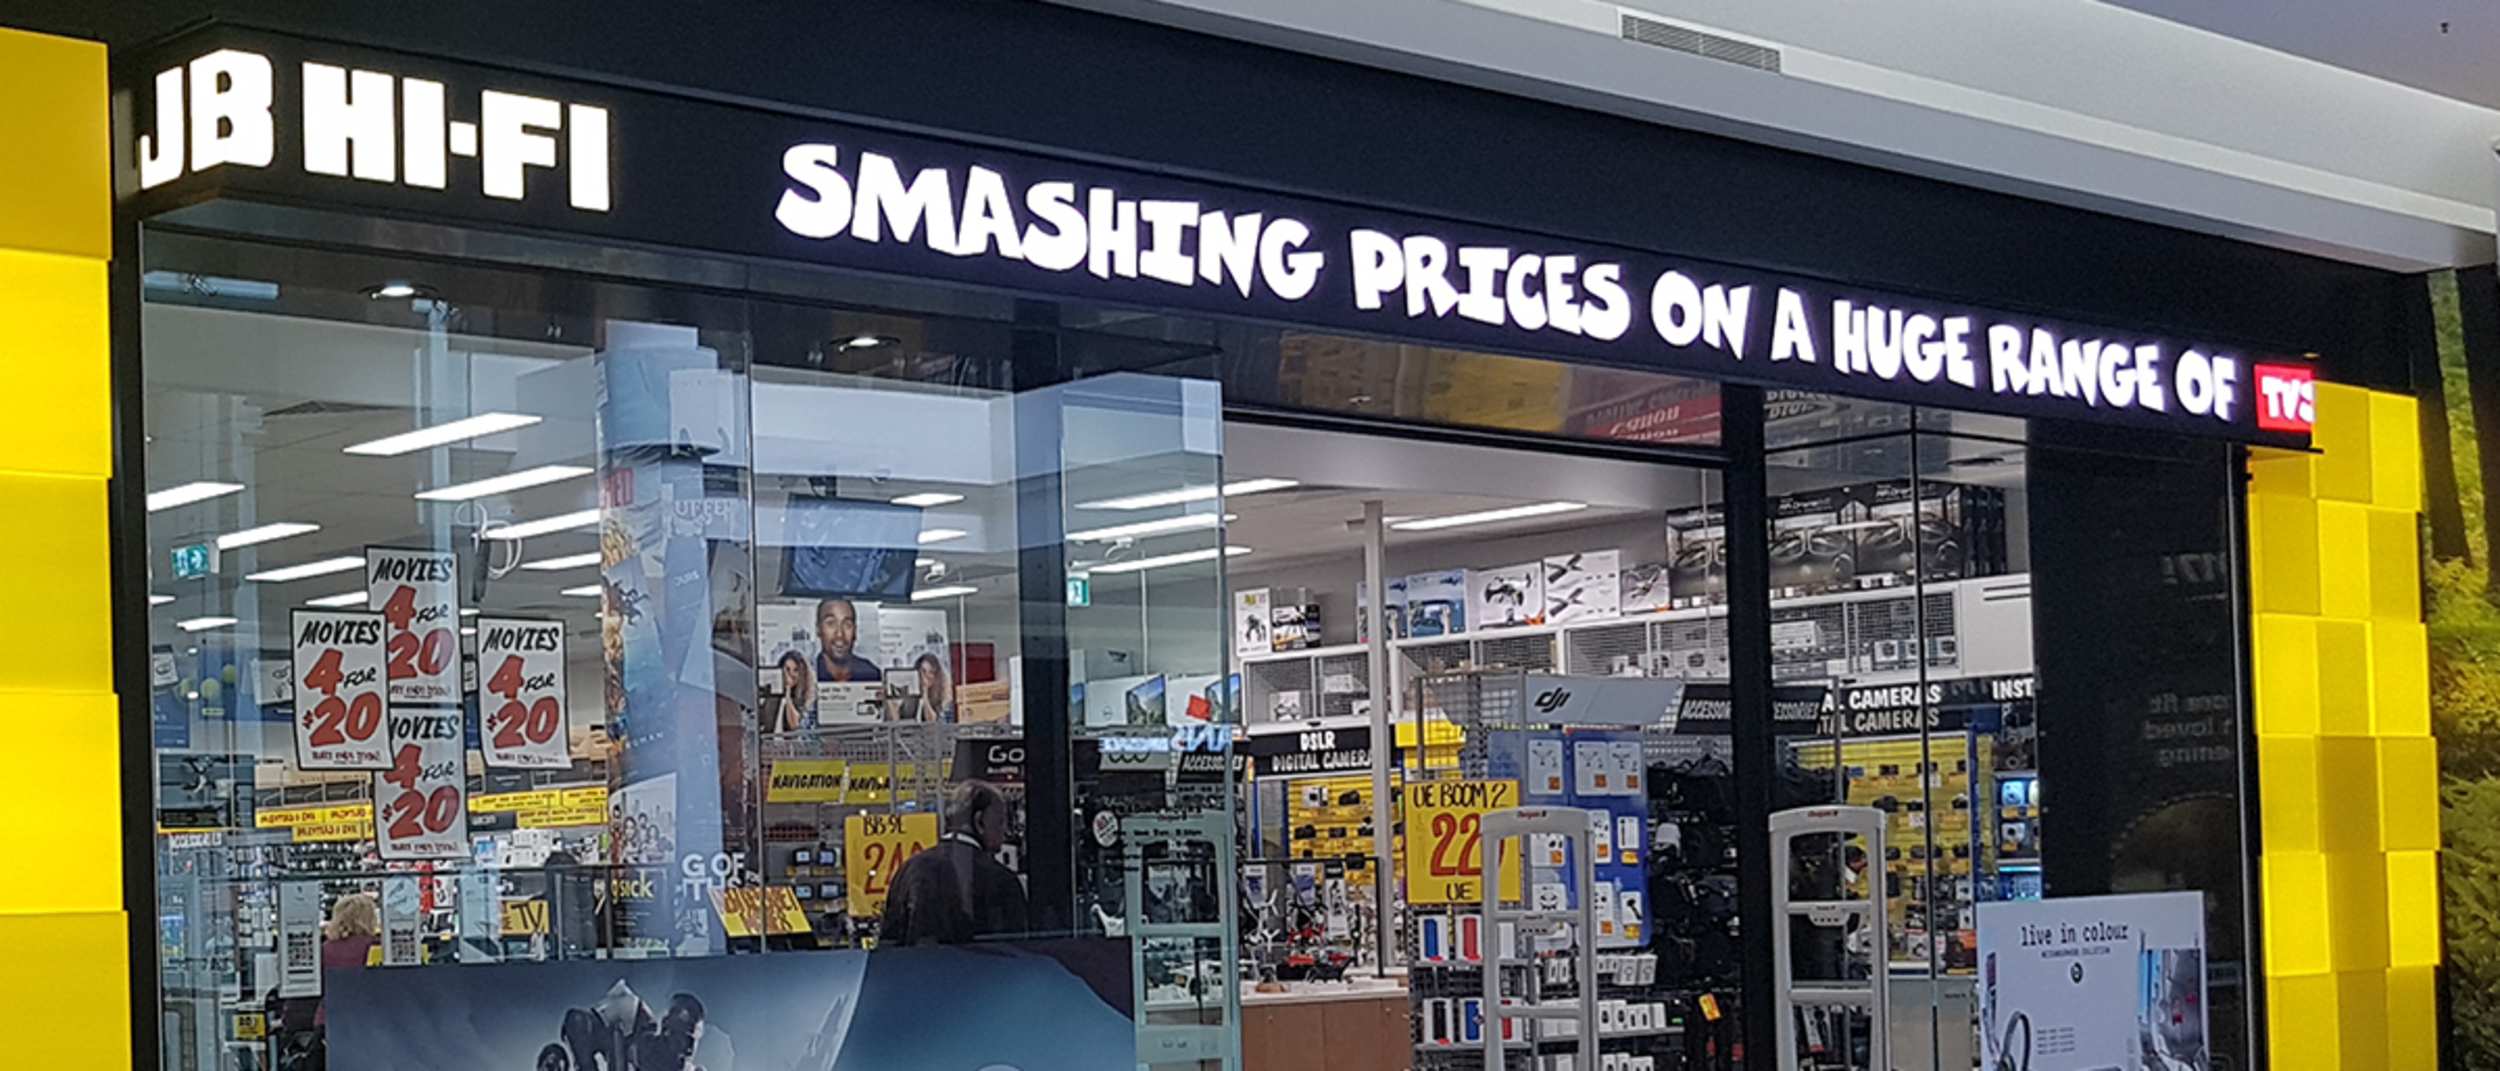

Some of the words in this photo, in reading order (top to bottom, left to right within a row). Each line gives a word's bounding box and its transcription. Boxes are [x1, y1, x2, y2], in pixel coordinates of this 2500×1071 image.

[140, 49, 274, 191] JB
[302, 62, 610, 212] HI-FI
[775, 143, 1324, 300] SMASHING
[1350, 229, 1631, 341] PRICES
[1651, 270, 1751, 360] ON
[1770, 287, 1816, 364] A
[1834, 300, 1975, 388] HUGE
[1988, 324, 2166, 412] RANGE
[2175, 349, 2237, 422] OF
[372, 557, 453, 584] MOVIES
[384, 585, 416, 630] 4
[416, 604, 448, 624] FOR
[298, 619, 381, 648] MOVIES
[482, 627, 559, 653] MOVIES
[304, 648, 344, 694] 4
[344, 667, 376, 688] FOR
[488, 654, 524, 699] 4
[524, 672, 555, 692] FOR
[1849, 684, 1942, 709] CAMERAS
[302, 691, 382, 747] $20
[487, 696, 560, 749] $20
[1300, 730, 1335, 751] DSLR
[383, 744, 422, 788] 4
[423, 761, 454, 781] FOR
[1272, 752, 1320, 772] DIGITAL
[772, 774, 842, 790] NAVIGATION
[1413, 784, 1436, 808] UE
[1440, 783, 1488, 808] BOOM
[1491, 783, 1508, 808] 2
[382, 785, 460, 840] $20
[1430, 812, 1505, 877] 22
[1446, 881, 1473, 901] UE
[511, 903, 543, 929] TV
[2021, 925, 2053, 947] live
[2060, 923, 2077, 944] in
[2082, 922, 2129, 943] colour
